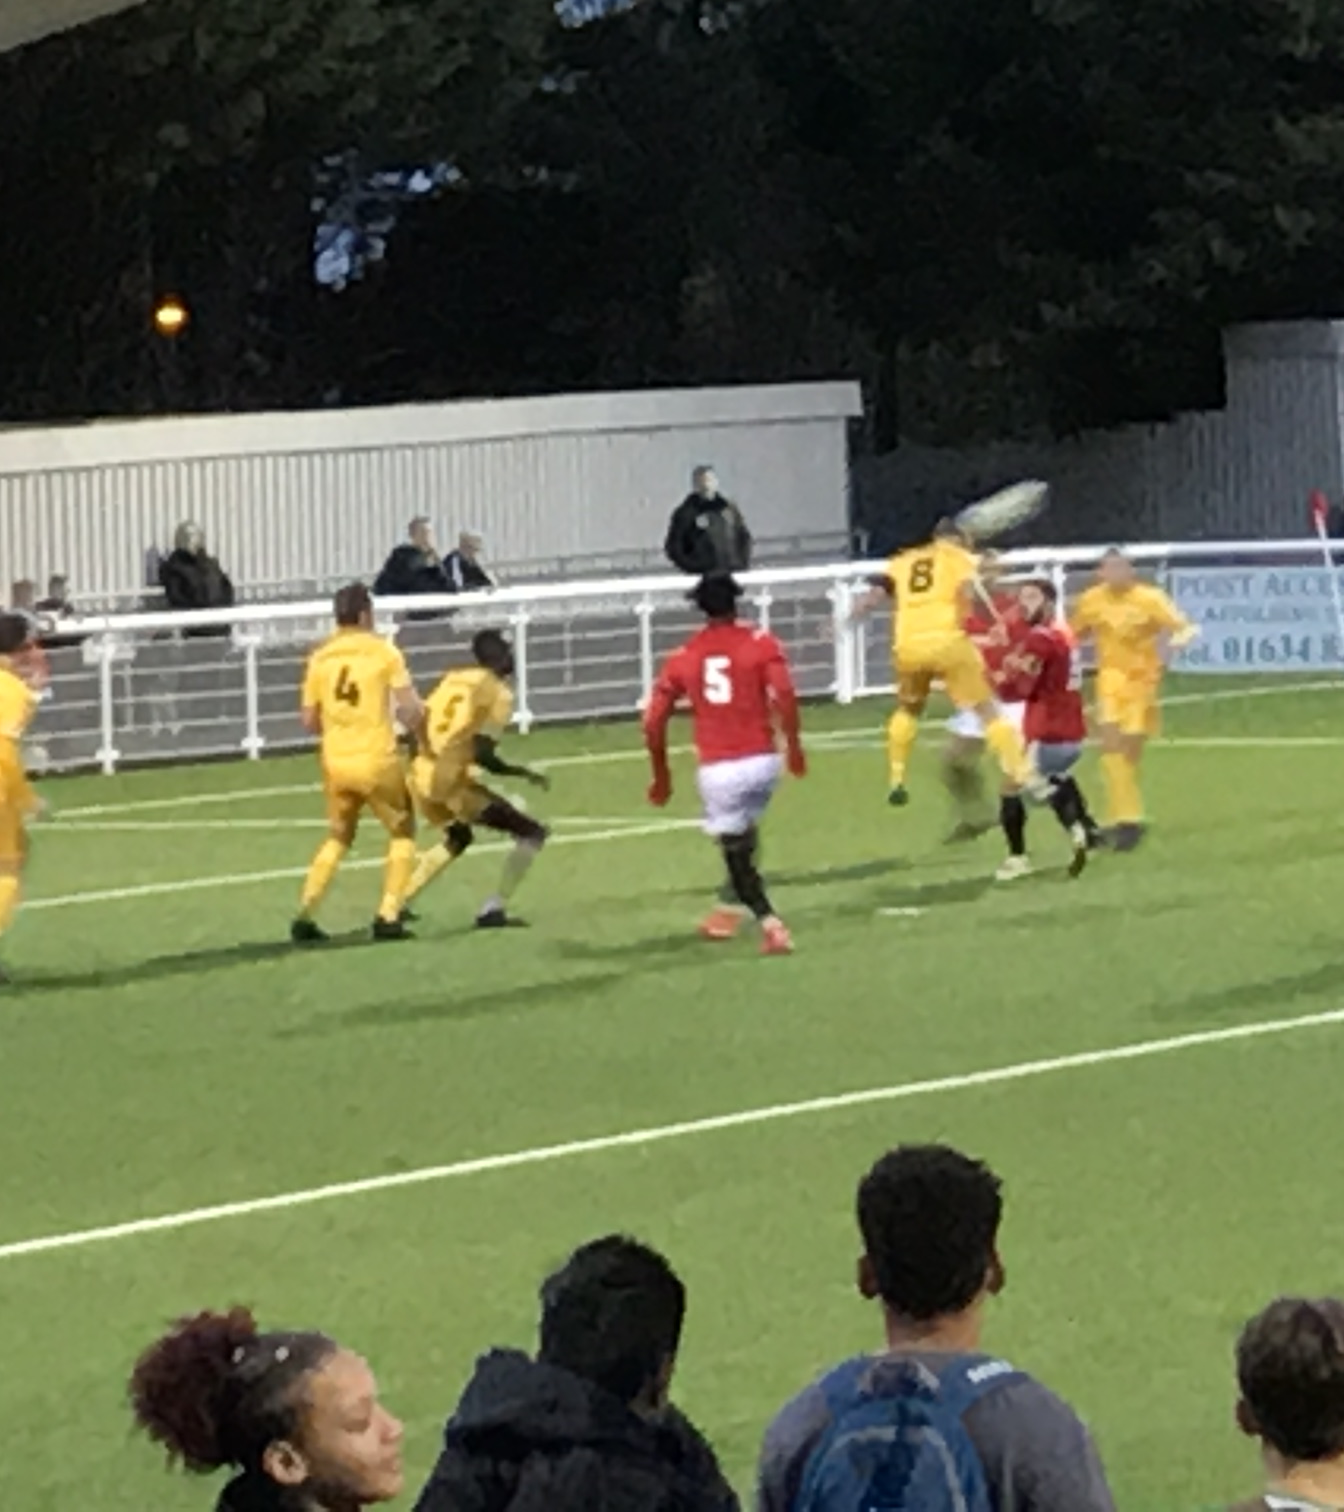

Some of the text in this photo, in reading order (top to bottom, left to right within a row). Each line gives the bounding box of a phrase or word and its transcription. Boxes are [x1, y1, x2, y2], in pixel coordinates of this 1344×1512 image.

[909, 557, 934, 594] 8
[1223, 633, 1311, 663] 01634
[335, 665, 360, 707] 4
[703, 655, 733, 704] 5
